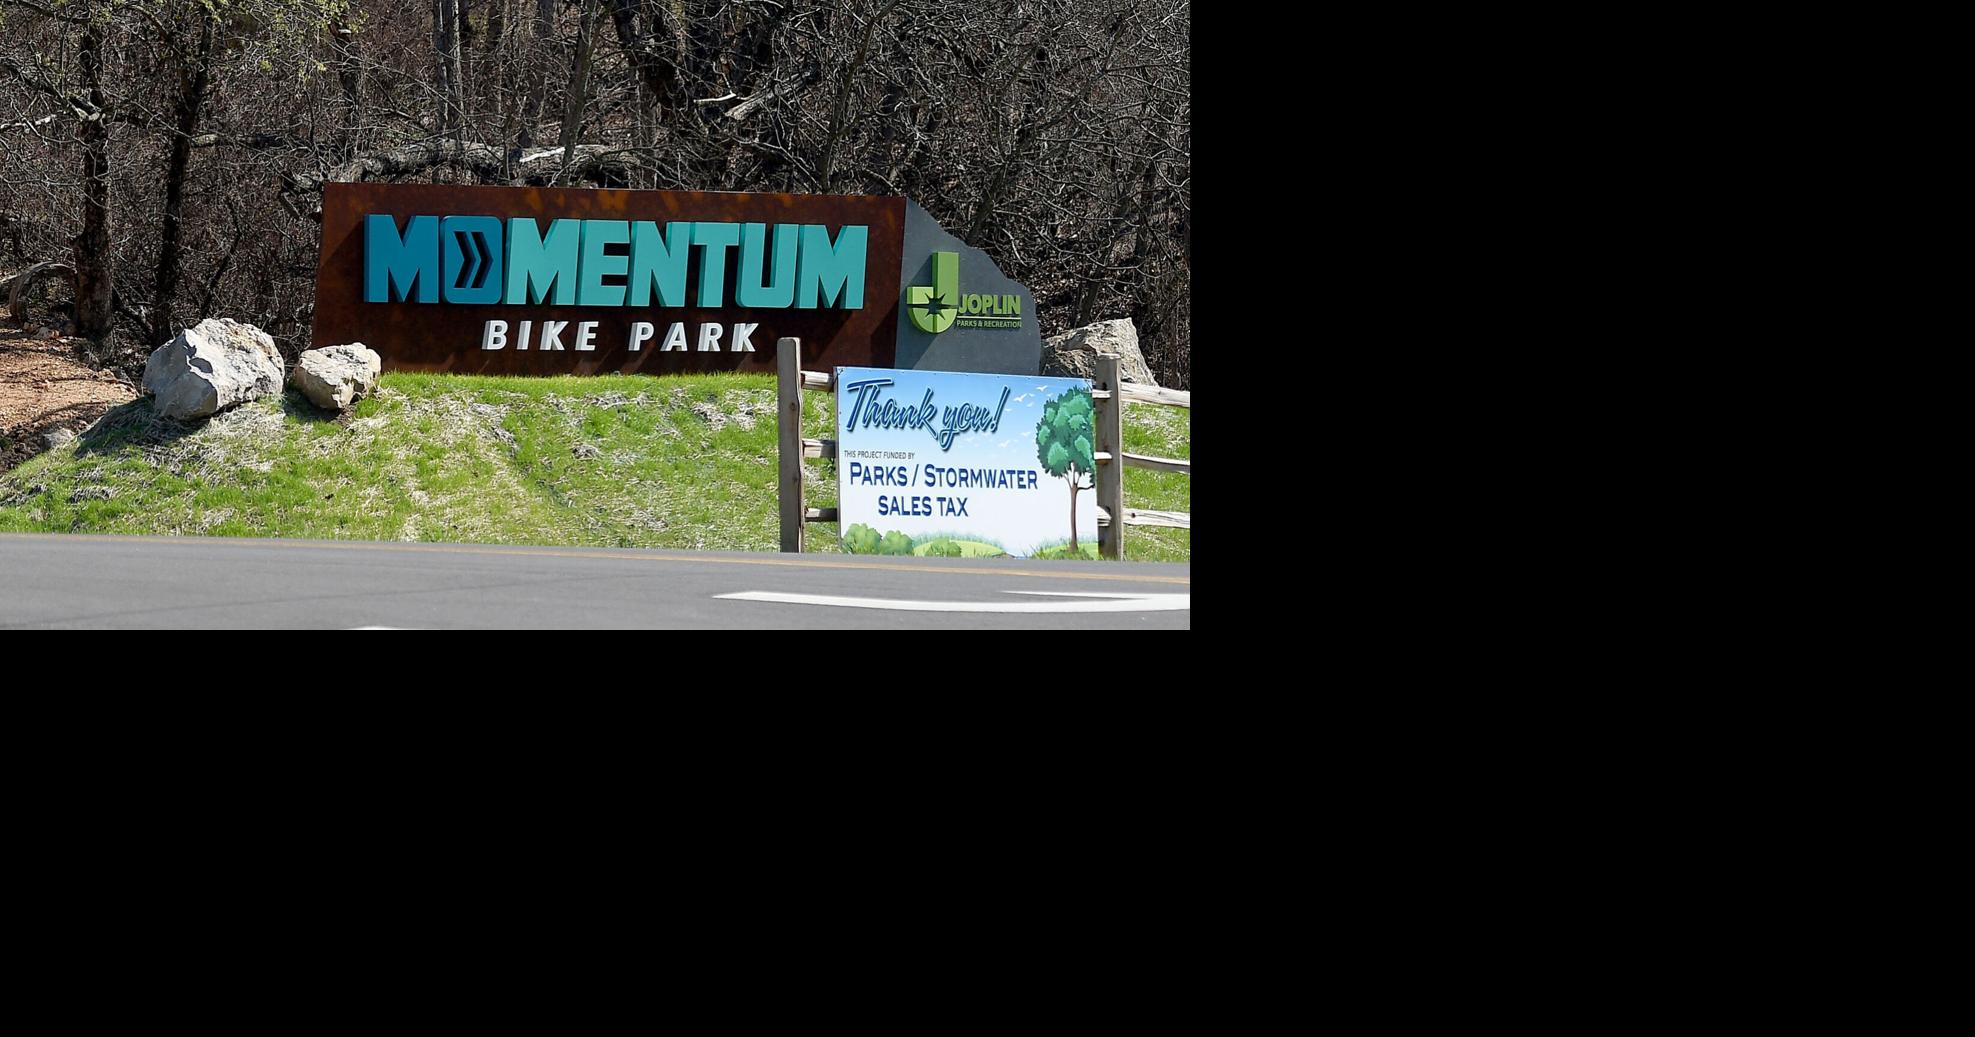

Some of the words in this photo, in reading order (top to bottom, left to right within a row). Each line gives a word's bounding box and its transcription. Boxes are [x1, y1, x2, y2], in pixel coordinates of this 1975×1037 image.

[364, 214, 869, 310] MOMENTUM
[958, 294, 1021, 315] JOPLIN
[482, 320, 599, 351] BIKE
[628, 322, 760, 353] PARK
[984, 320, 1021, 328] RECREATION
[846, 378, 940, 441] Thank
[935, 385, 1011, 451] you!
[844, 450, 856, 458] THIS
[857, 451, 882, 459] PROJECT
[883, 451, 905, 460] FUNDED
[906, 452, 915, 460] BY
[850, 462, 907, 487] PARKS
[912, 464, 920, 487] /
[924, 464, 1038, 490] STORMWATER
[878, 495, 932, 516] SALES
[935, 497, 969, 517] TAX
